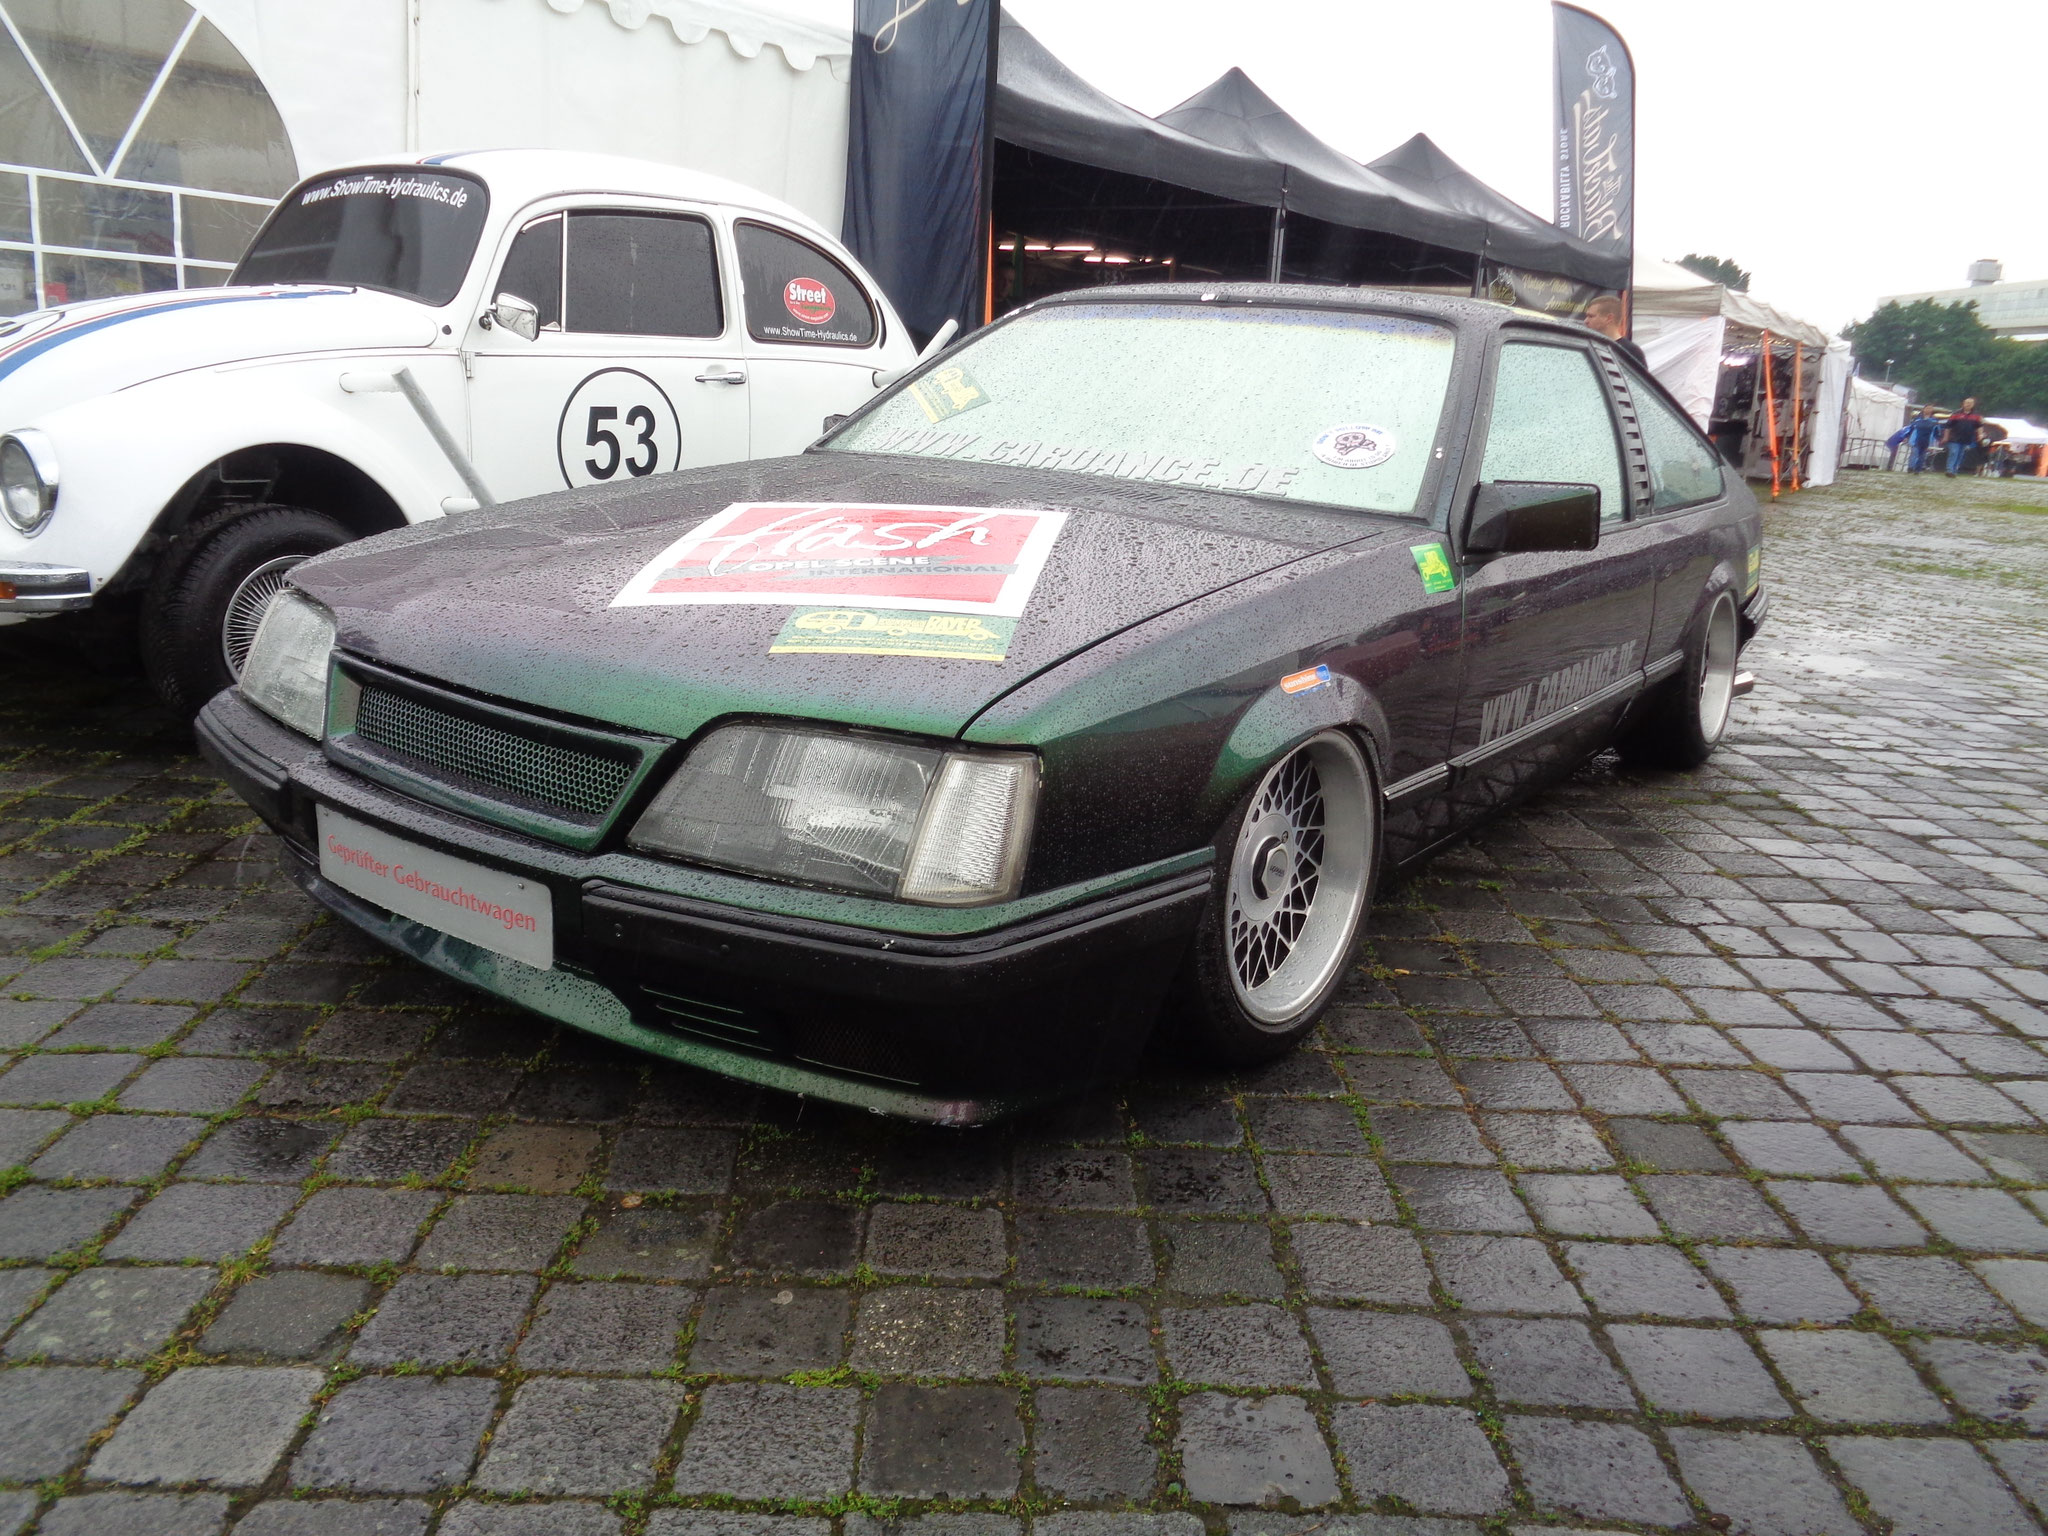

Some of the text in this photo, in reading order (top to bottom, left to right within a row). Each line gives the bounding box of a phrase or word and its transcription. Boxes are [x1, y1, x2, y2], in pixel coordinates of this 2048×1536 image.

[301, 175, 468, 208] www.ShowTime-Hydraulics.de
[788, 282, 826, 304] Street
[763, 326, 858, 342] www.ShowTime-Hydraulics.de
[584, 404, 659, 480] 53
[750, 556, 931, 572] OPEL SCENE
[808, 565, 1002, 577] INTERNATIONAL
[327, 834, 537, 933] Geprüfter Gebrauchtwagen
